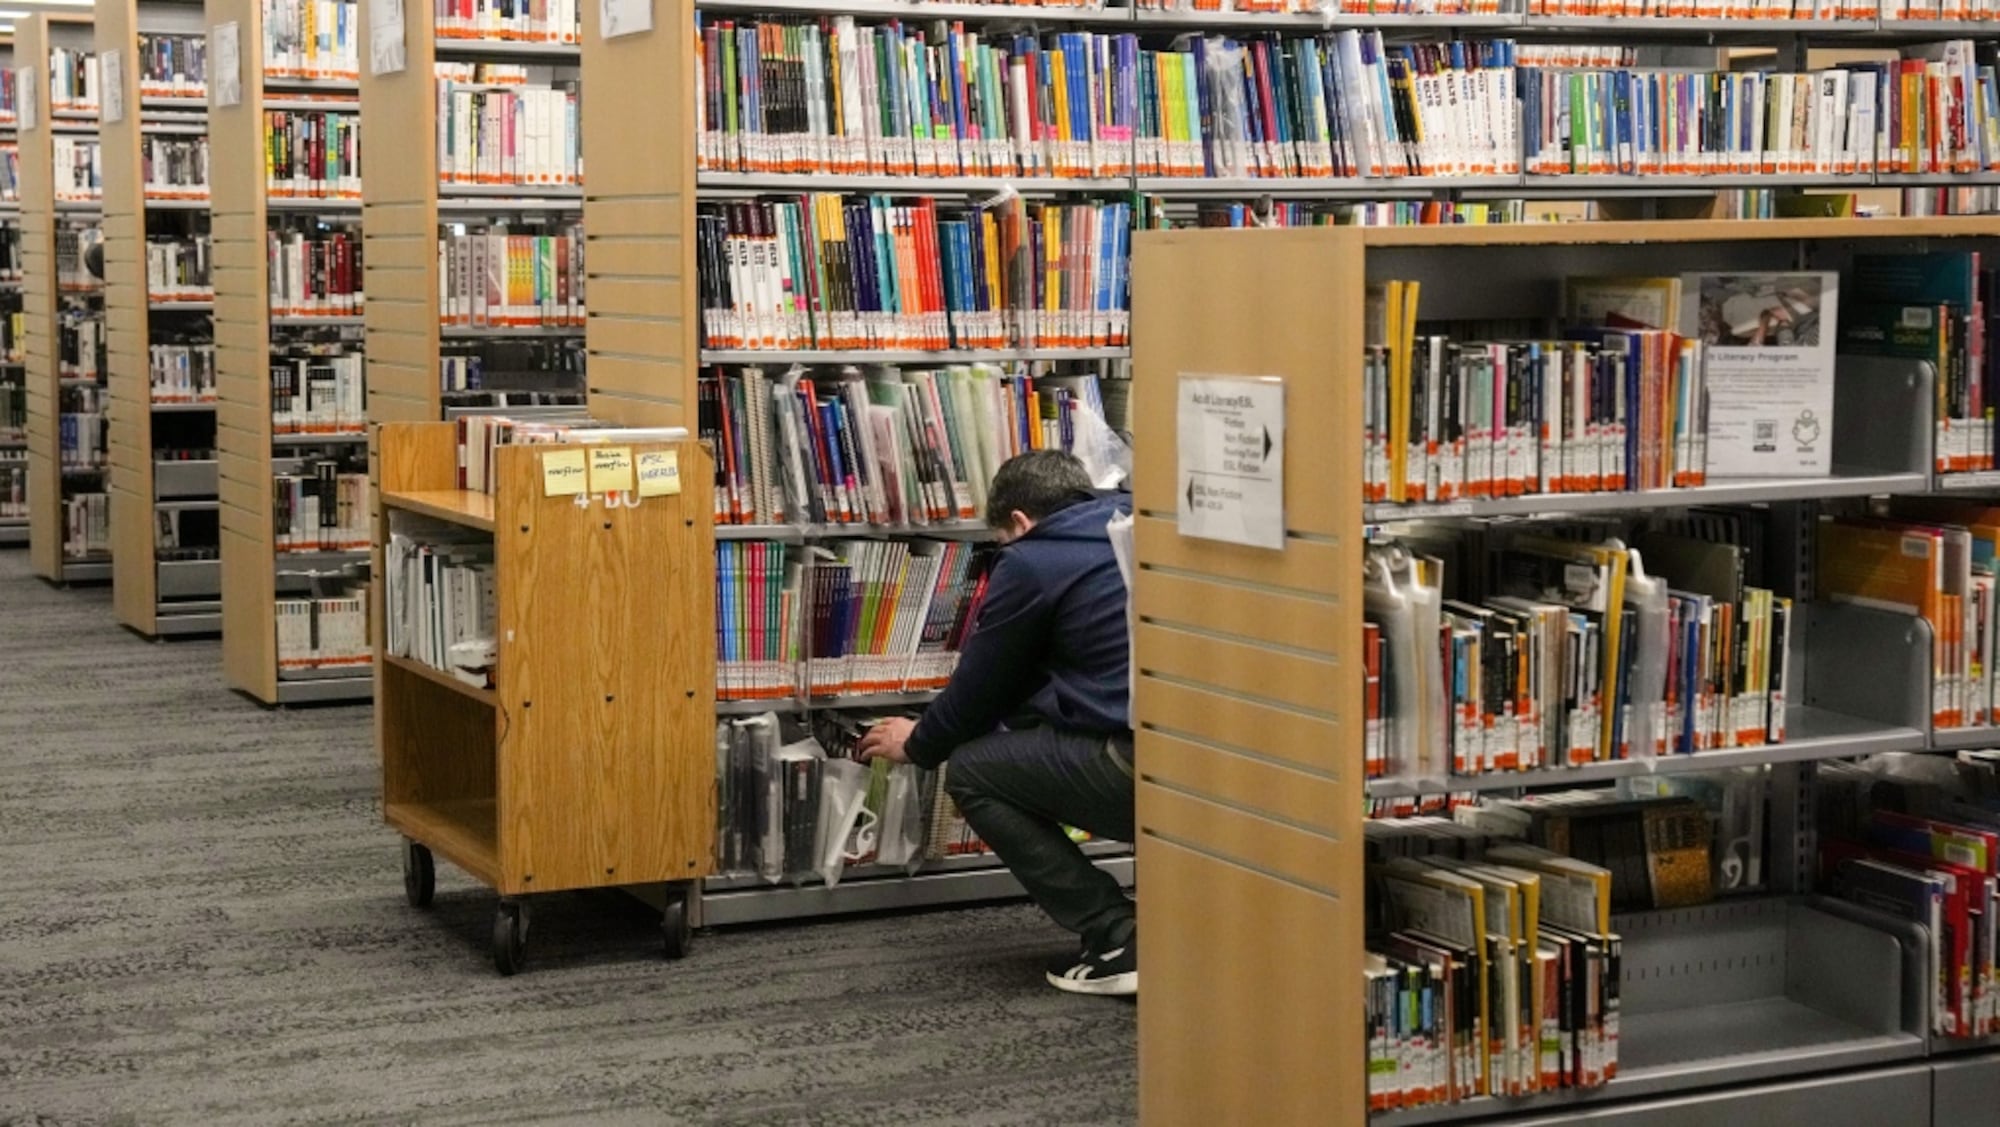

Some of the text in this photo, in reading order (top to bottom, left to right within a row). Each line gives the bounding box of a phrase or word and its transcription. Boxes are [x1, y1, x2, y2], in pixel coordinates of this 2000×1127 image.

[1447, 73, 1457, 106] IELTS
[1718, 353, 1755, 362] Literacy
[1758, 353, 1799, 362] Program
